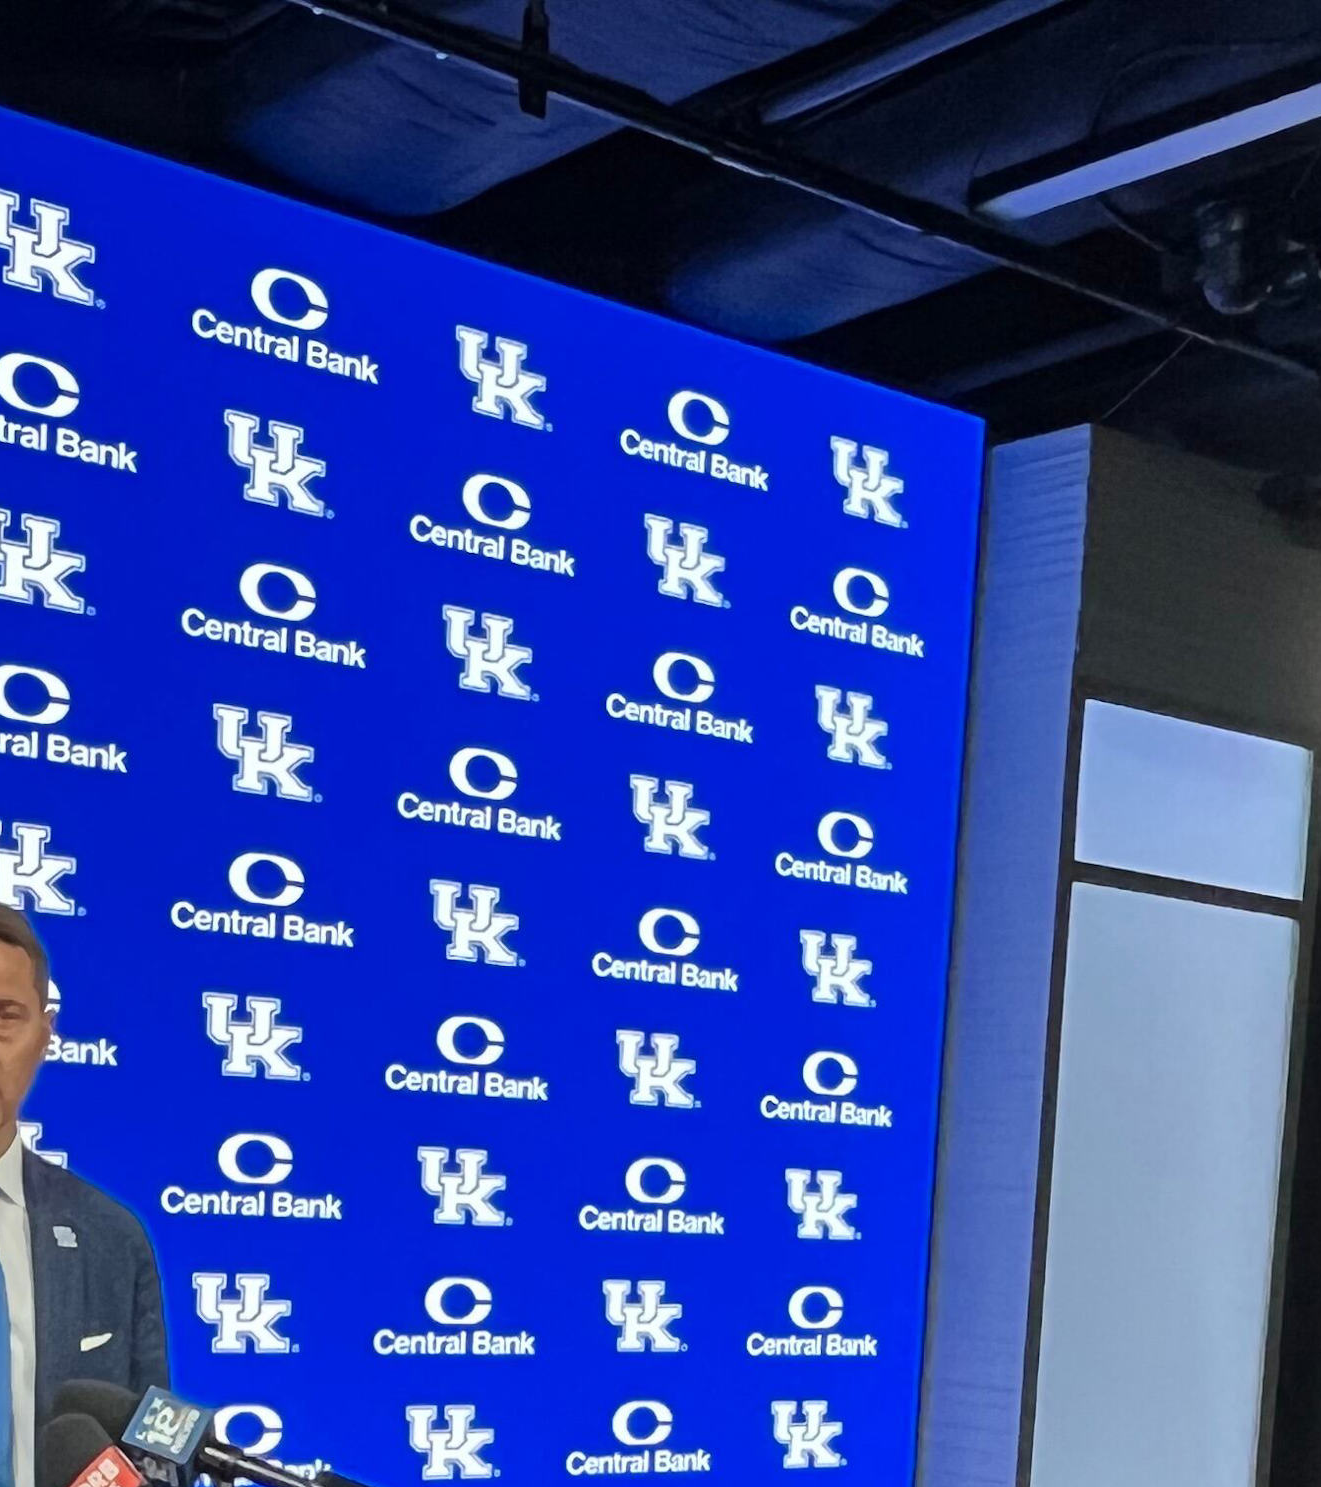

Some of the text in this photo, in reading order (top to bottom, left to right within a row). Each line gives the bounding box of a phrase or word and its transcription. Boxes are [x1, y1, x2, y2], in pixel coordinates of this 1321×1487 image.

[191, 308, 379, 385] Central Bank
[55, 427, 138, 474] Bank
[620, 428, 769, 492] Central Bank
[409, 514, 575, 577] Central Bank
[181, 607, 366, 669] Central Bank
[789, 605, 925, 658] Central Bank
[605, 692, 754, 744] Central Bank
[46, 733, 128, 773] Bank
[397, 791, 562, 841] Central Bank
[774, 851, 908, 895] Central Bank
[170, 900, 355, 948] Central Bank
[591, 951, 739, 992] Central Bank
[384, 1063, 548, 1101] Central Bank
[760, 1094, 893, 1128] Central Bank
[160, 1185, 342, 1220] Central Bank
[578, 1204, 725, 1235] Central Bank
[373, 1328, 535, 1356] Central Bank
[746, 1332, 878, 1357] Central Bank
[565, 1448, 711, 1476] Central Bank
